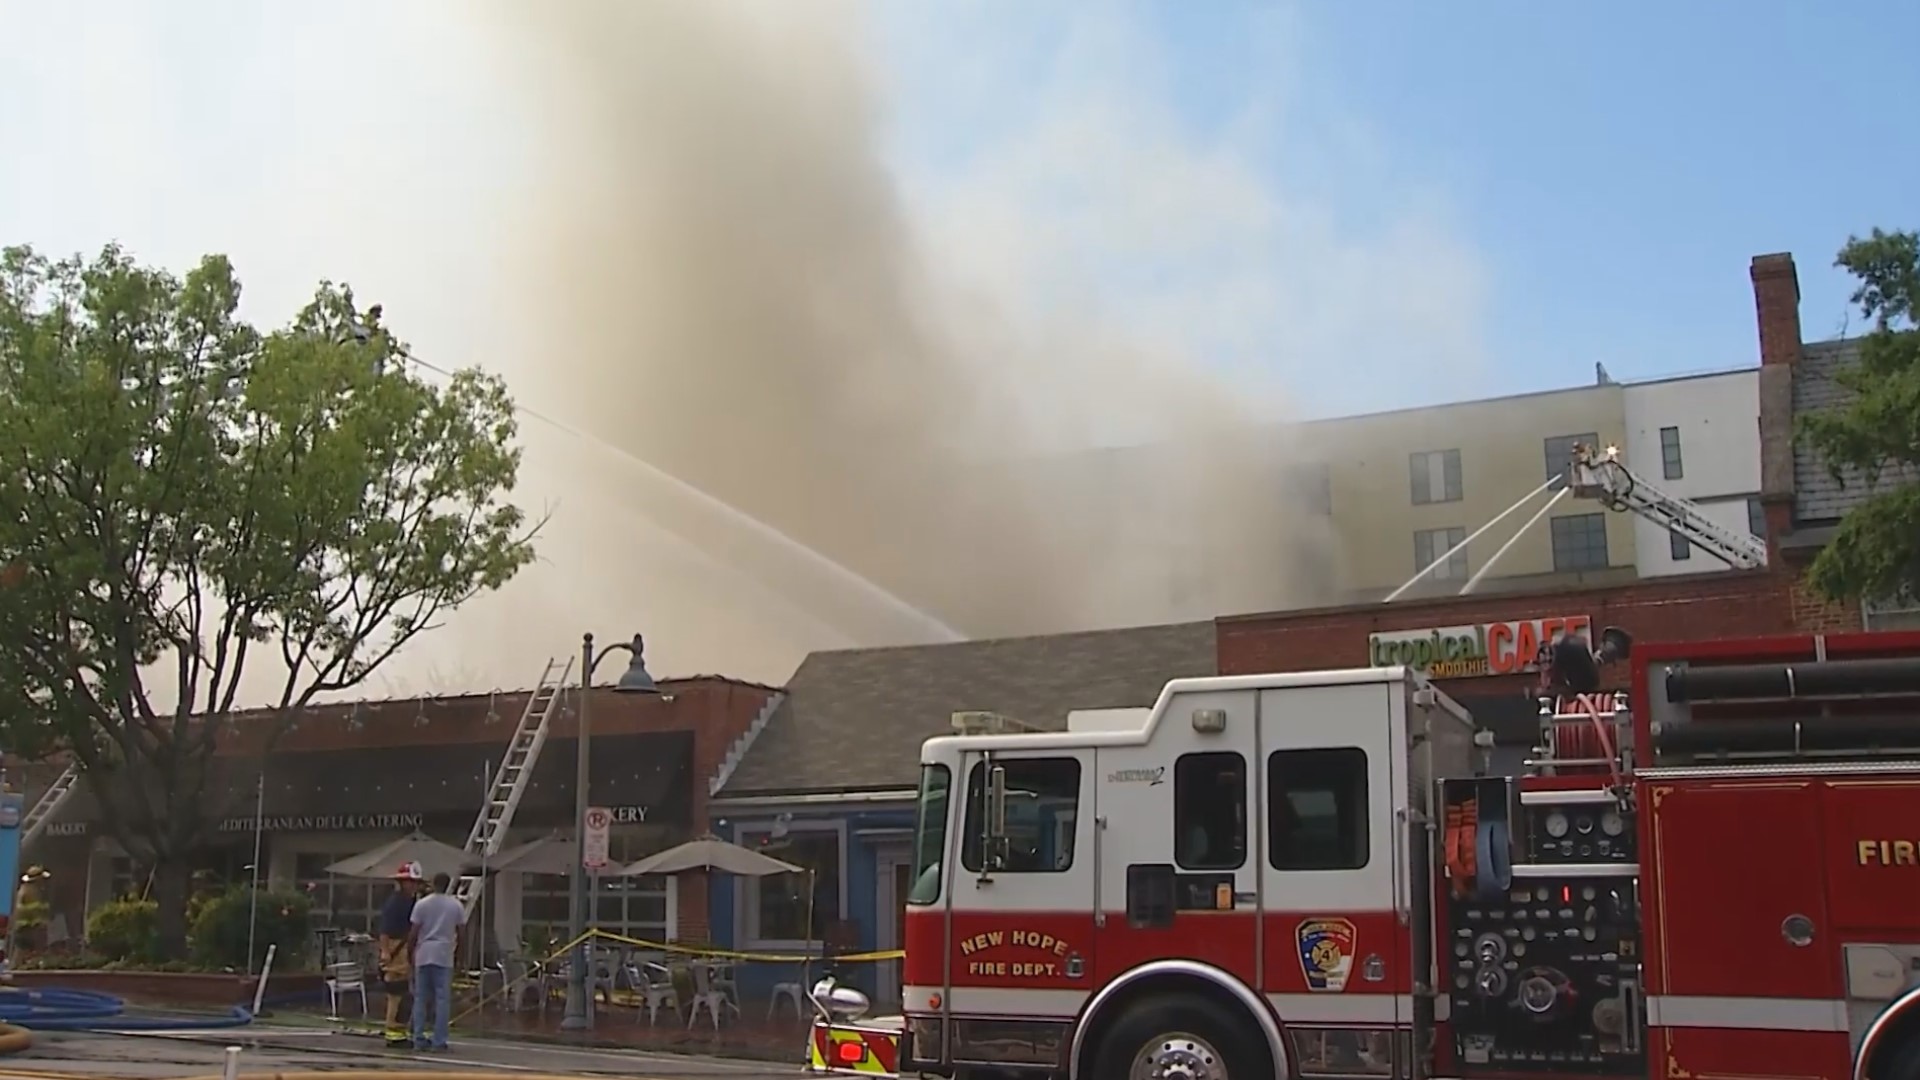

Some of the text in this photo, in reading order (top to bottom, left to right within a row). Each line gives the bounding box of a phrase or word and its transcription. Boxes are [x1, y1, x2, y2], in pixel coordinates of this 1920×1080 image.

[1372, 626, 1485, 671] tropical
[1430, 660, 1488, 678] SMOOTHIE
[219, 812, 423, 831] EDITERANEAN DELI & CATERING
[608, 805, 648, 822] KERY
[46, 821, 87, 836] BAKERY
[1858, 840, 1920, 865] FIR
[961, 930, 1068, 957] NEW HOPE
[969, 962, 1061, 976] FIRE DEPT.
